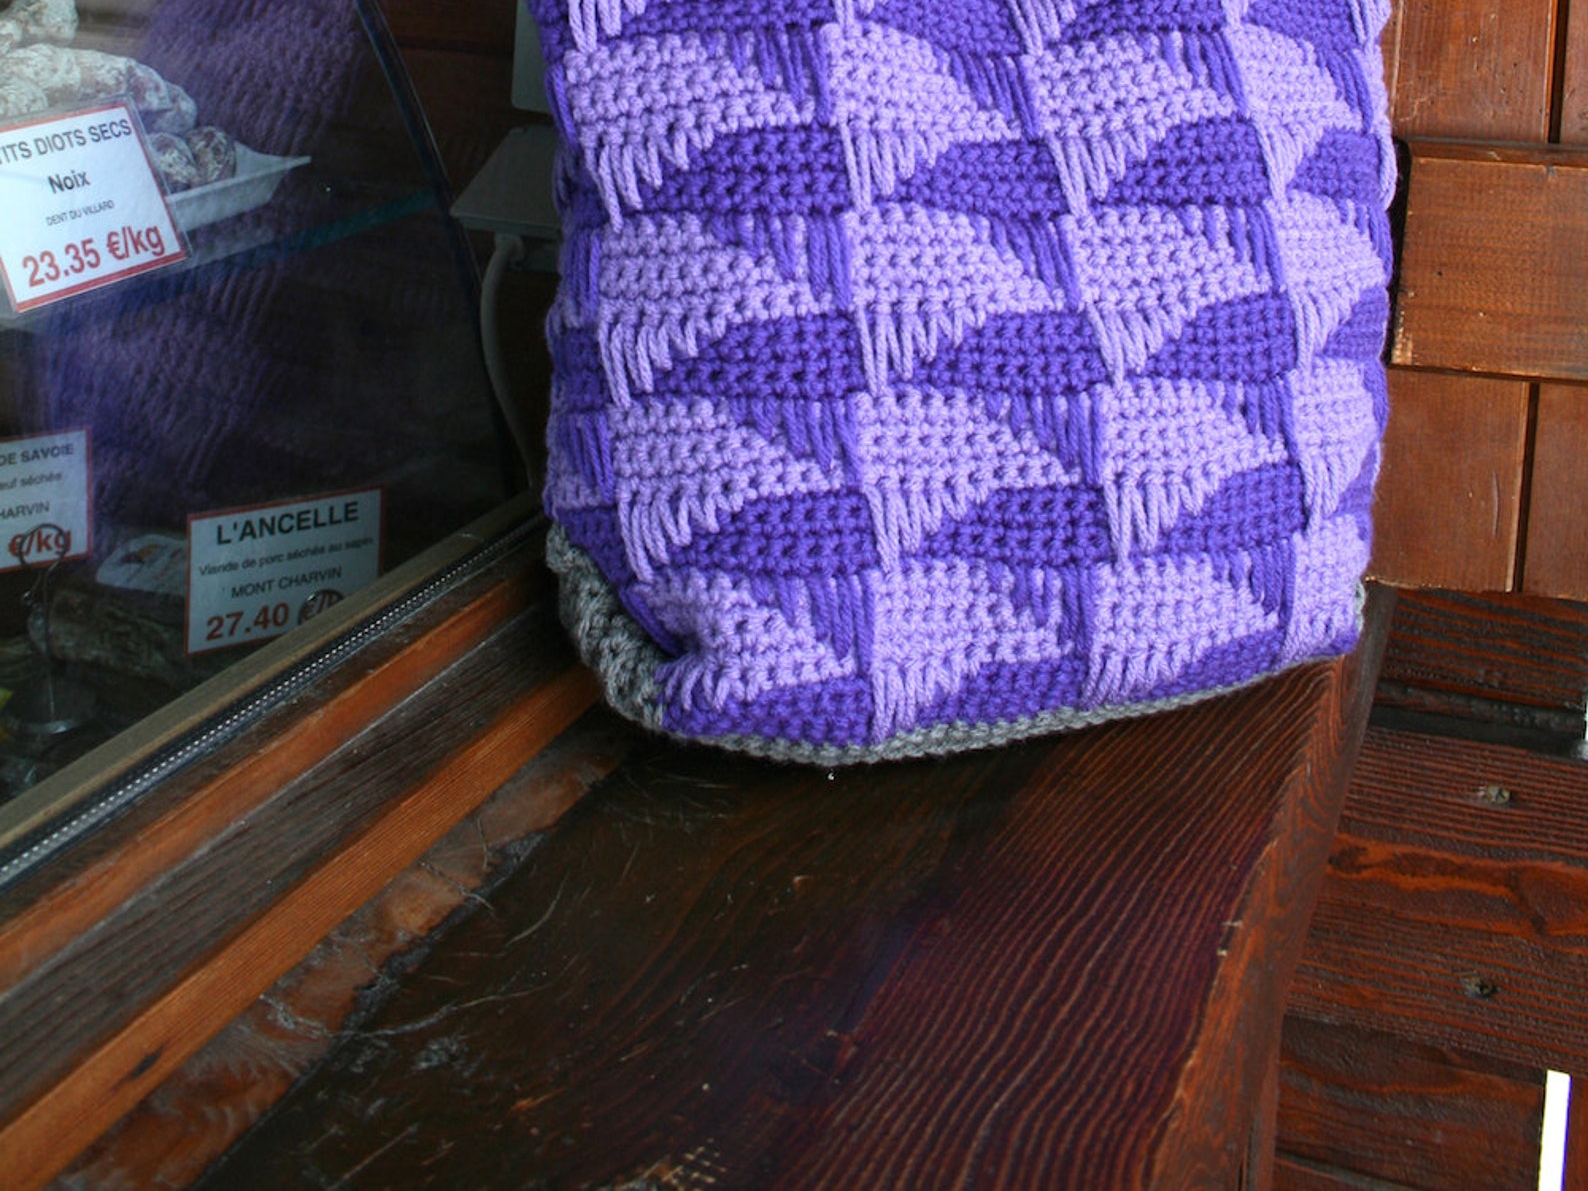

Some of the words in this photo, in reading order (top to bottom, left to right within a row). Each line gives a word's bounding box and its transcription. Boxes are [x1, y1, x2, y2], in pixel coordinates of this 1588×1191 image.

[0, 140, 33, 164] ITS
[34, 129, 87, 156] DIOTS
[88, 118, 132, 143] SECS
[47, 170, 91, 194] Noix
[46, 211, 68, 226] DENT
[69, 209, 82, 220] DU
[82, 199, 115, 216] VILLARD
[22, 237, 101, 288] 23.35
[106, 225, 165, 261] €/kg
[20, 443, 74, 463] SAVOIE
[217, 501, 360, 545] L'ANCELLE
[8, 529, 72, 558] €/kg
[199, 560, 239, 576] Viande
[241, 557, 257, 570] de
[258, 553, 285, 569] porc
[328, 542, 343, 553] au
[231, 578, 277, 599] MONT
[277, 566, 343, 590] CHARVIN
[205, 602, 290, 642] 27.40
